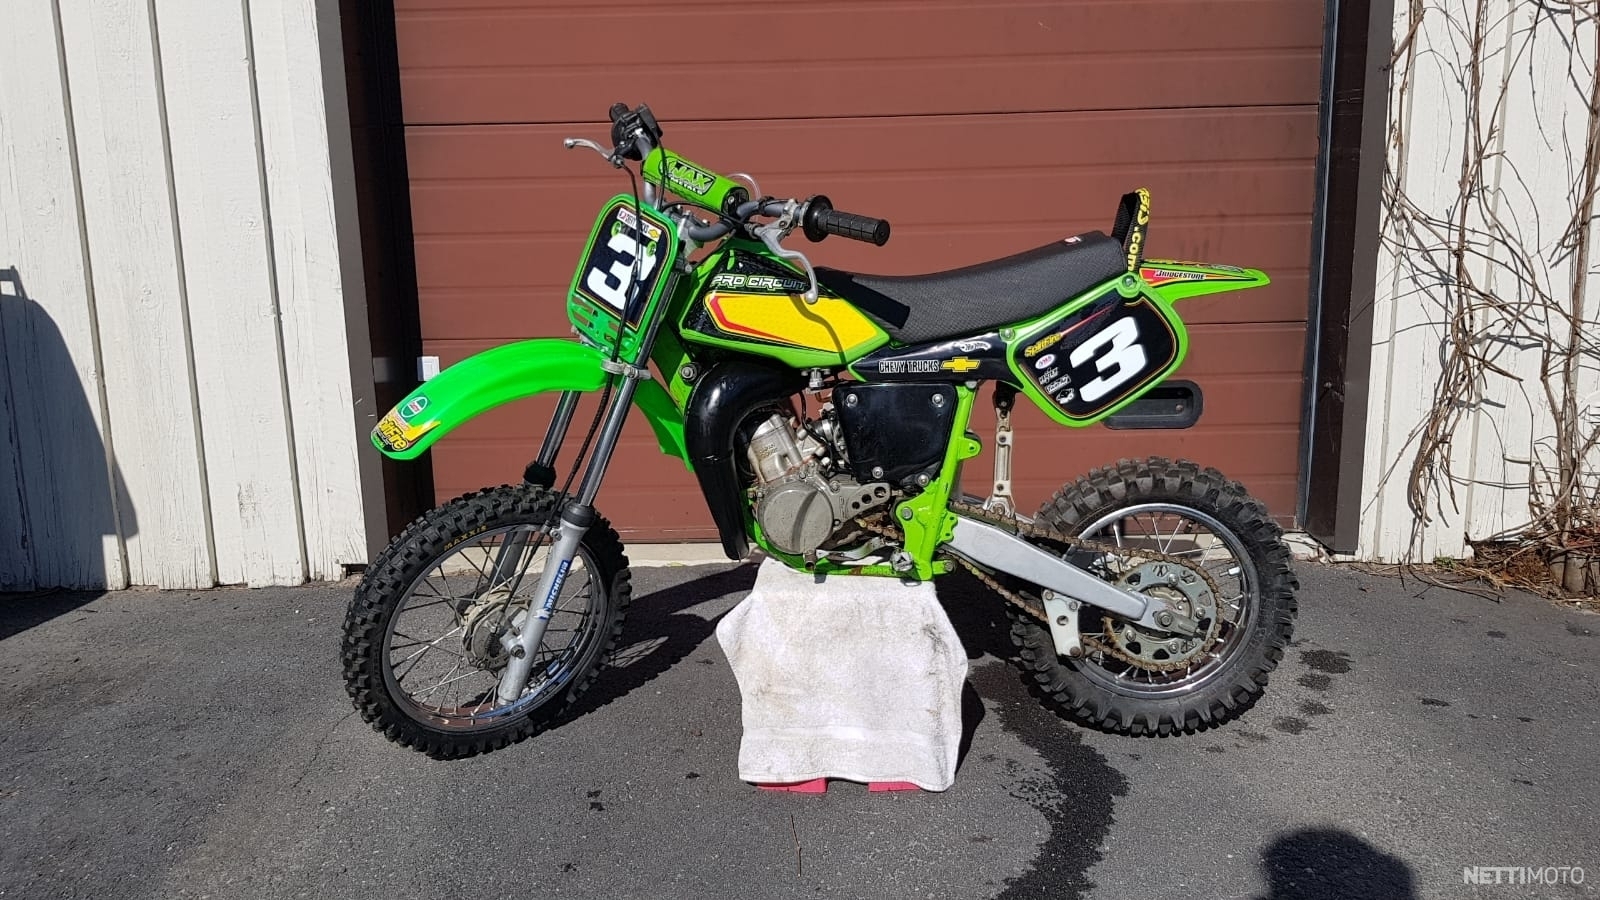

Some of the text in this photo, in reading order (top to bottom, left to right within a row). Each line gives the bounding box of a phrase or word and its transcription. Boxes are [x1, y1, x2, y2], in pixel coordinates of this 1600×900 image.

[587, 232, 657, 310] 3
[710, 273, 806, 290] PRO CIRCUIT
[1155, 269, 1205, 280] BRIDGESTONE
[878, 359, 940, 374] CHEVY TRUCKS
[1070, 316, 1146, 402] 3
[545, 560, 569, 609] MICHELIN
